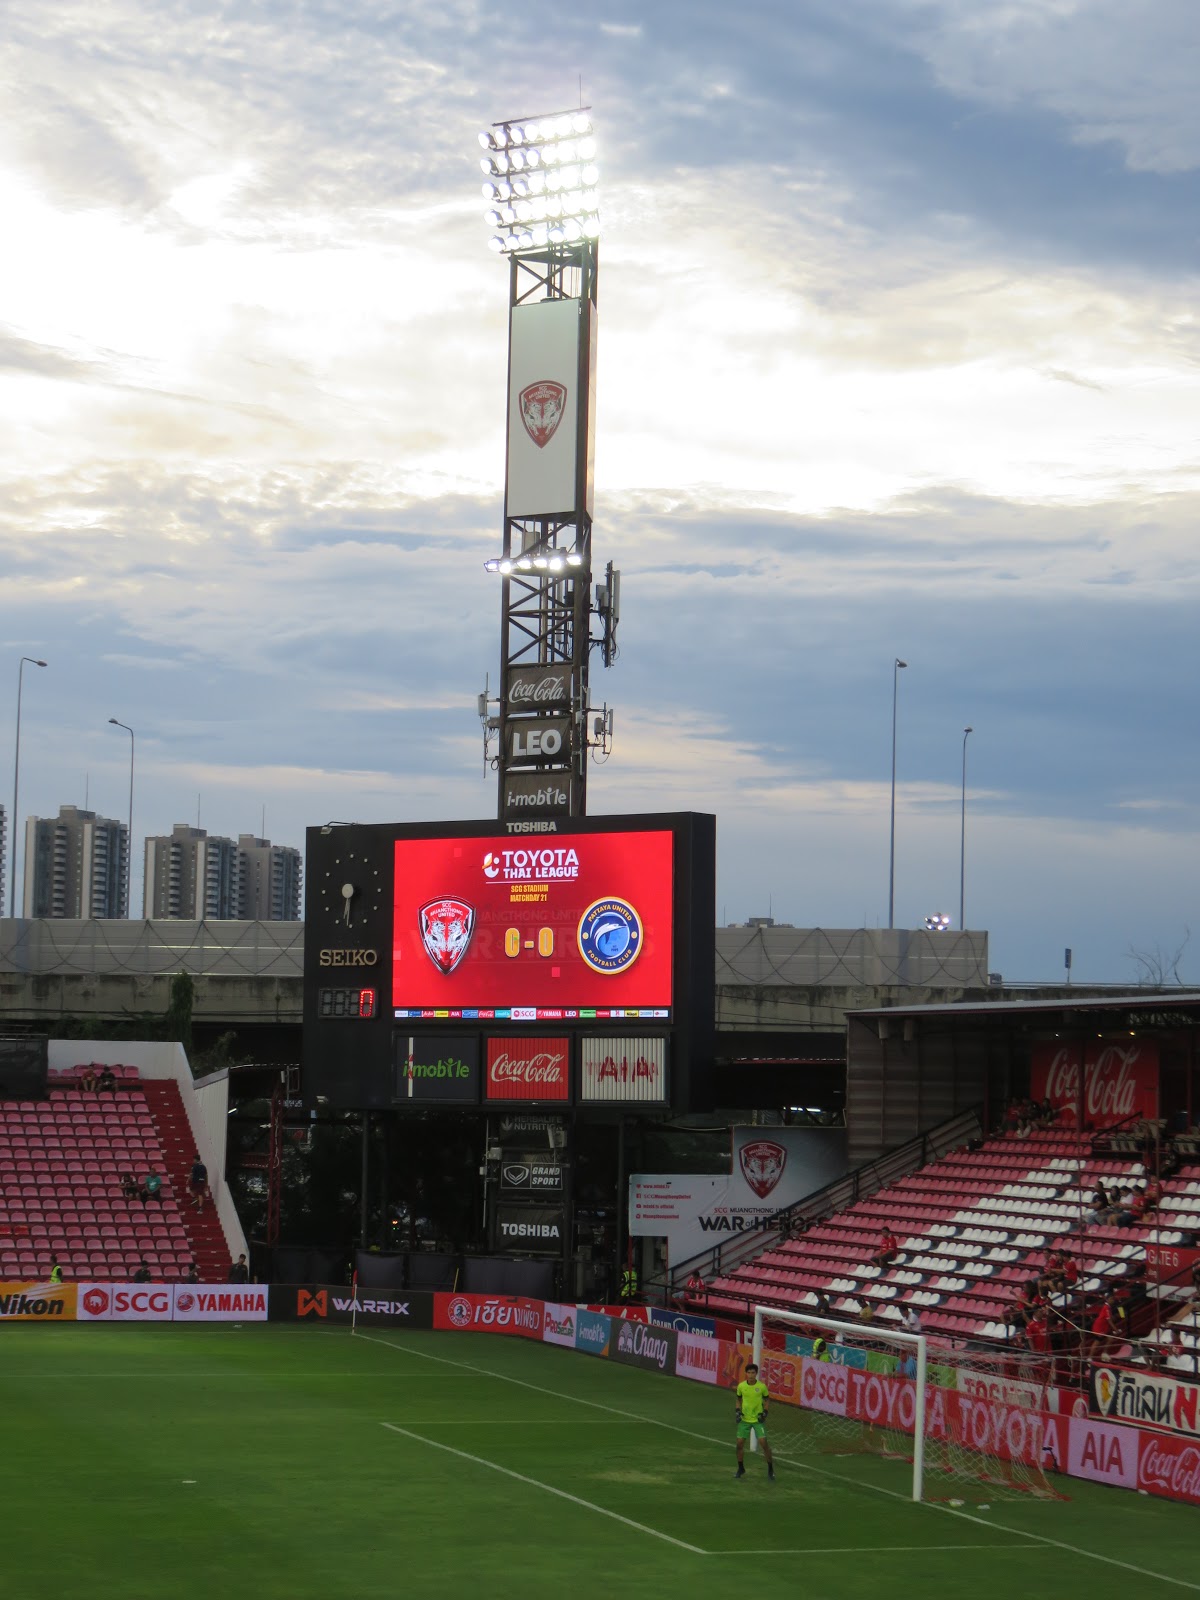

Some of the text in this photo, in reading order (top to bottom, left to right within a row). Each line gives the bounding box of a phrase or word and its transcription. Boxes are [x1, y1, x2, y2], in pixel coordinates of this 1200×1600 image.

[512, 730, 562, 756] LEO
[507, 787, 567, 807] i-mobile
[506, 821, 557, 833] TOSHIBA
[502, 849, 579, 868] TOYOTA
[503, 866, 579, 879] THAI LEAGUE
[511, 884, 549, 893] SCG STADIUM
[510, 894, 547, 902] MATCHDAY 21
[588, 904, 632, 922] PATTAYA UNITED
[320, 949, 377, 966] SEIKO
[587, 949, 632, 967] FOOTBALL CLUB
[520, 1010, 535, 1018] SCG
[403, 1057, 470, 1080] imobile
[491, 1053, 565, 1083] Coca-Cola
[532, 1167, 560, 1175] GRAND
[532, 1177, 560, 1185] SPORT
[501, 1223, 560, 1237] TOSHIBA
[698, 1216, 744, 1231] WAR
[1147, 1249, 1179, 1267] GATE 6
[0, 1294, 64, 1315] Nikon
[114, 1292, 169, 1312] SCG
[197, 1293, 266, 1312] YAMAHA
[332, 1297, 410, 1315] WARRIX
[634, 1324, 668, 1368] Chang
[686, 1345, 717, 1372] YAMAHA
[819, 1374, 845, 1402] SCG
[1121, 1377, 1173, 1424] กิเลน
[958, 1398, 1062, 1468] TOYOTA
[1080, 1432, 1124, 1476] AIA
